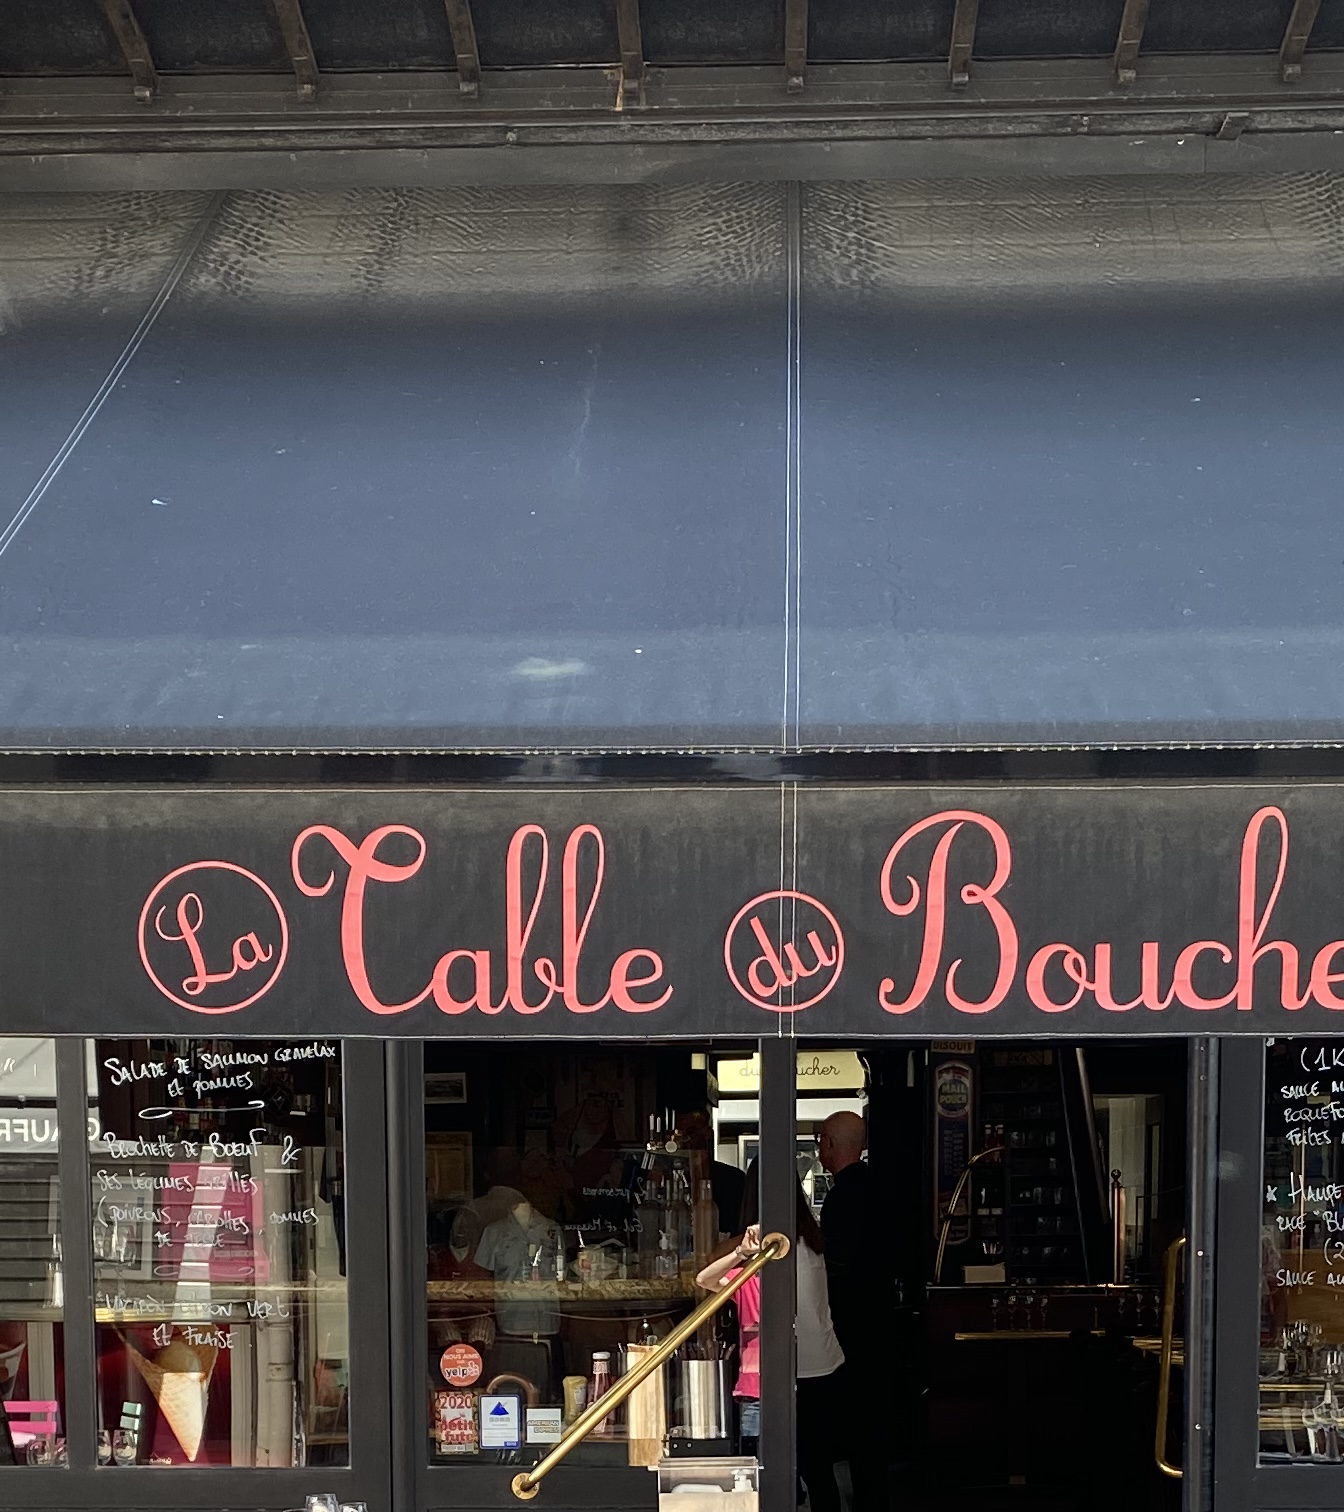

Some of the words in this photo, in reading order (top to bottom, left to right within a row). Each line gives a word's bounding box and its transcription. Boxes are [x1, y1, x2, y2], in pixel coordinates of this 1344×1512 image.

[155, 892, 273, 996] La
[290, 823, 672, 1016] Table
[746, 915, 837, 998] du
[174, 1057, 192, 1075] DE
[796, 1057, 840, 1076] ucher
[181, 1140, 198, 1158] DE
[445, 1366, 468, 1379] yelp
[439, 1395, 472, 1409] 2020
